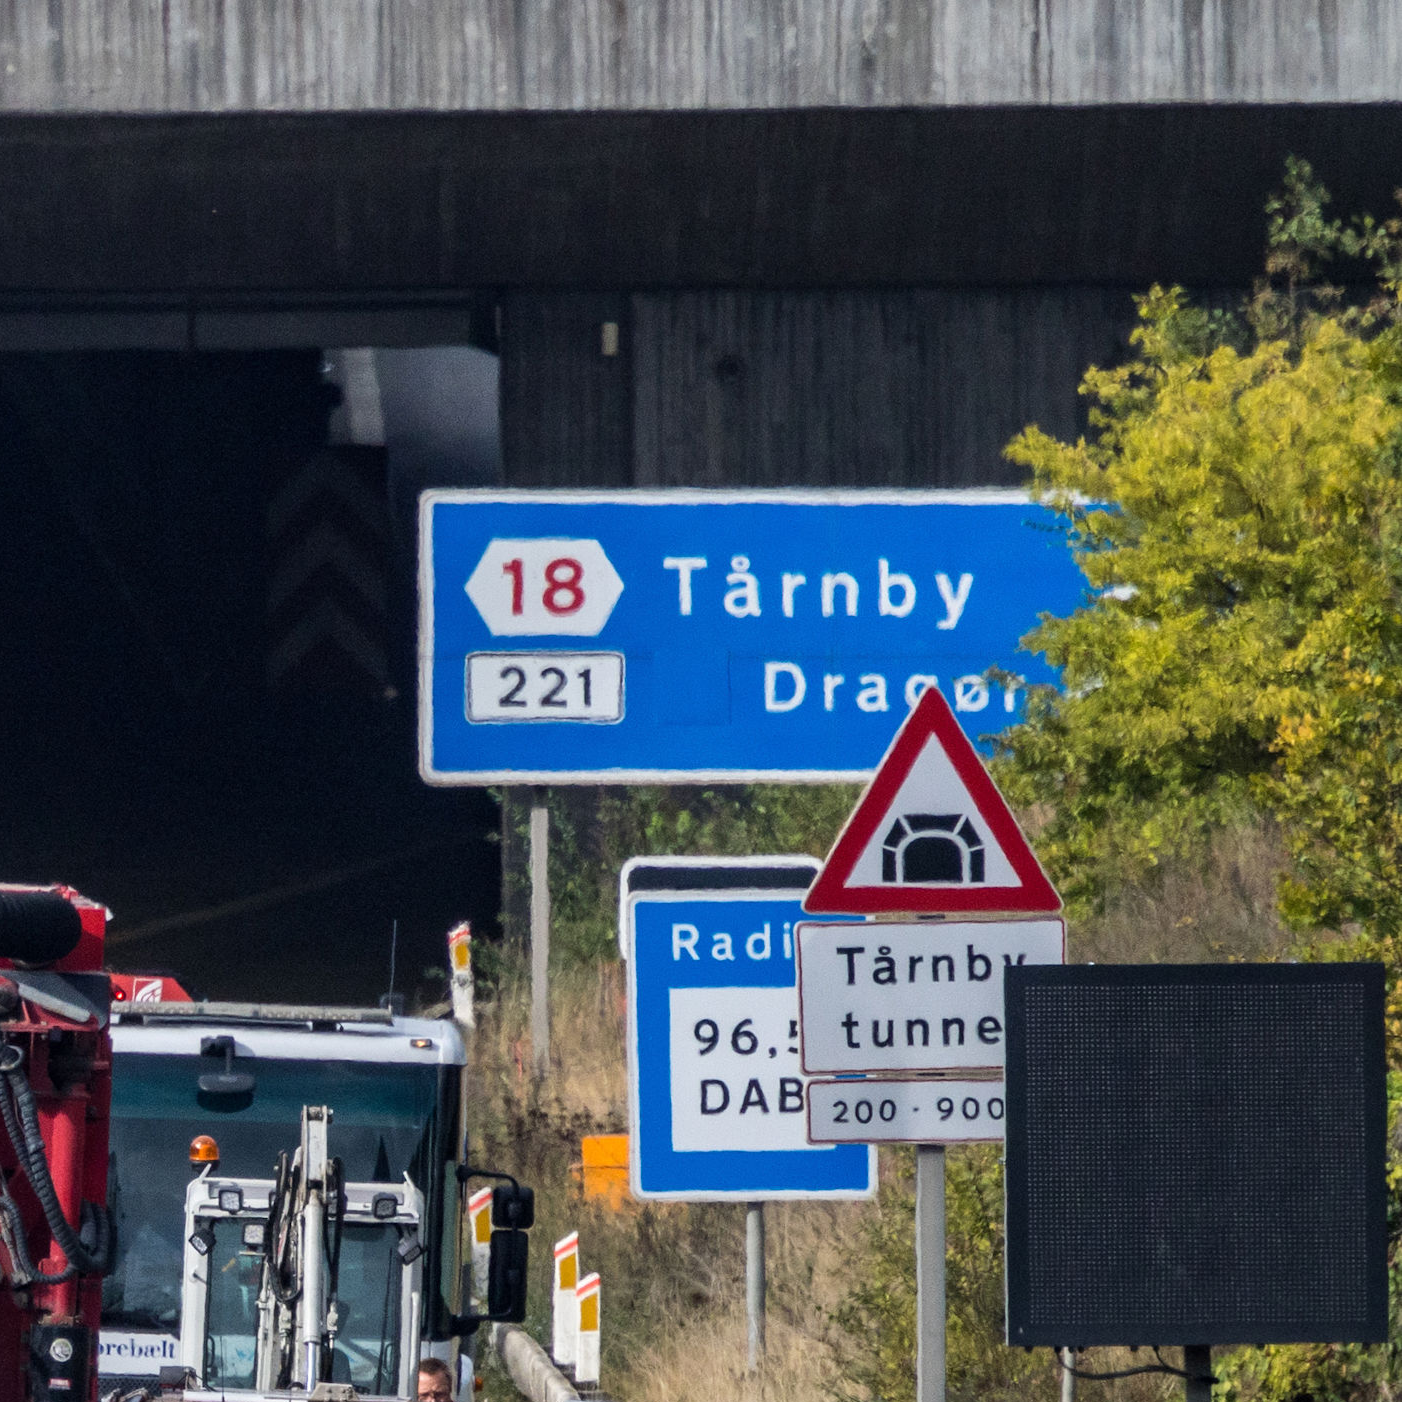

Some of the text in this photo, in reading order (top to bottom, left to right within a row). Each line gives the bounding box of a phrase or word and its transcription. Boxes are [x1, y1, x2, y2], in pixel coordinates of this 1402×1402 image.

[502, 554, 975, 631] 18 Tårnby
[498, 666, 593, 707] 221
[671, 922, 793, 962] Radi
[835, 944, 1027, 986] Tårnb
[842, 1011, 1002, 1050] tunne
[699, 1077, 805, 1116] DAB
[832, 1099, 897, 1124] 200
[936, 1097, 1005, 1122] 900
